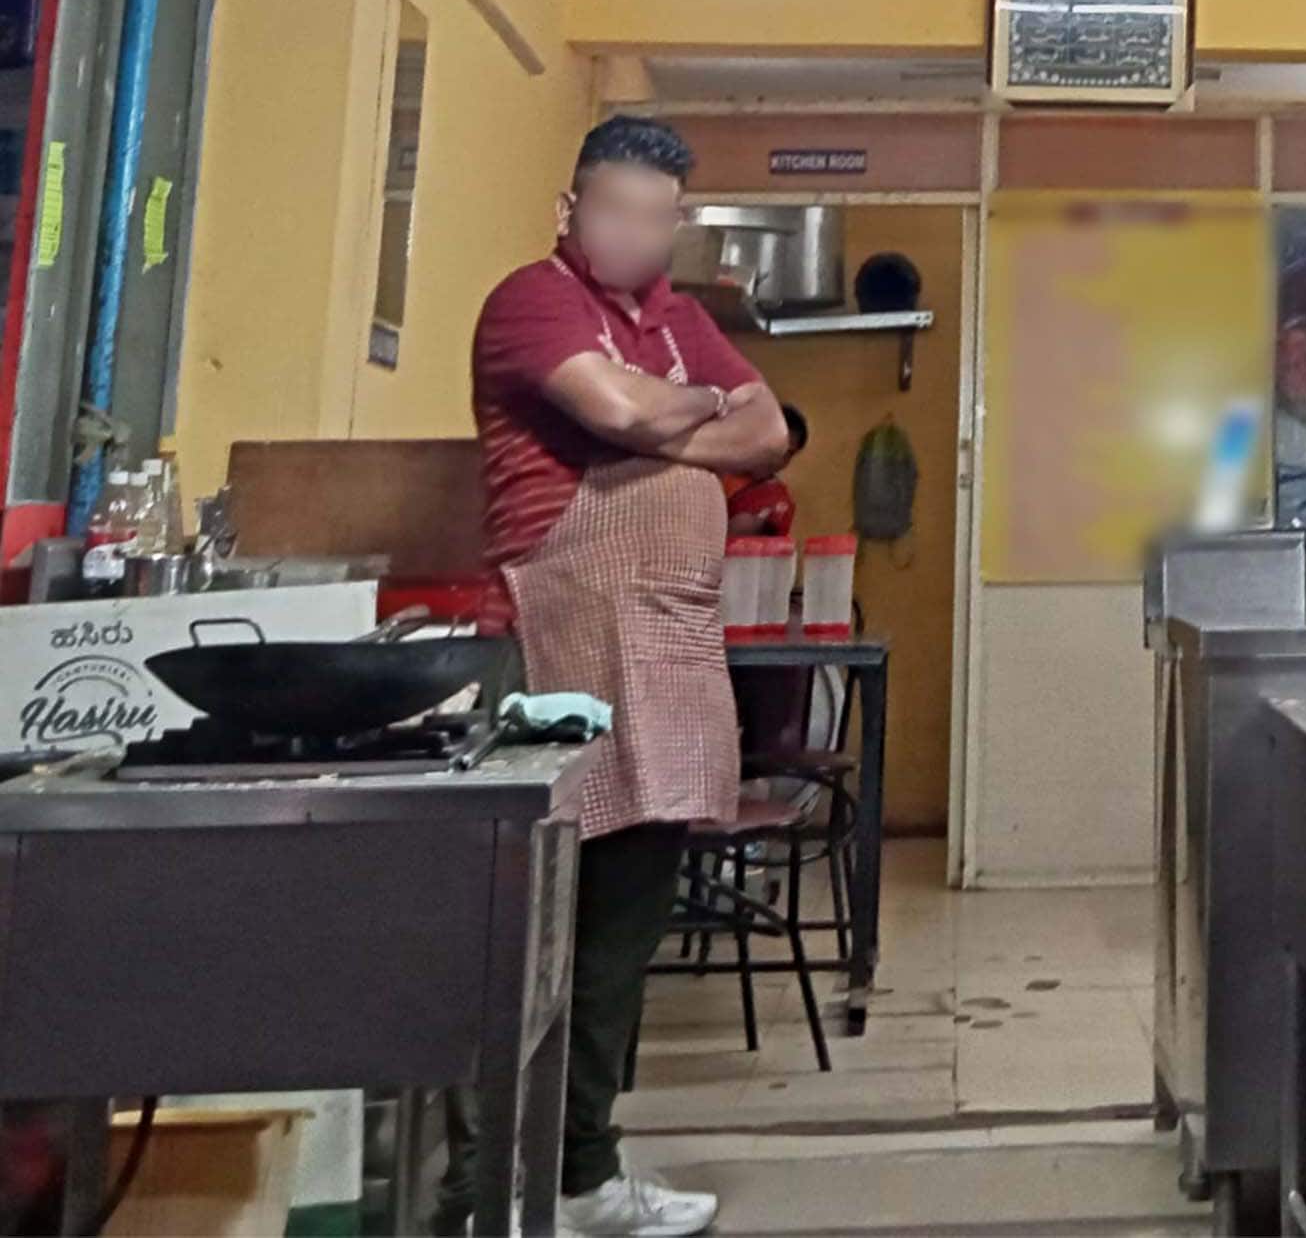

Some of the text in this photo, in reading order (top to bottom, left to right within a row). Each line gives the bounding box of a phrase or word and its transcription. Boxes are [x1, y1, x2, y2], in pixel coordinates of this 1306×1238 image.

[771, 153, 864, 170] KITCHEN ROOM
[51, 620, 133, 648] ಹಸಿರು
[20, 696, 157, 744] Hasiru
